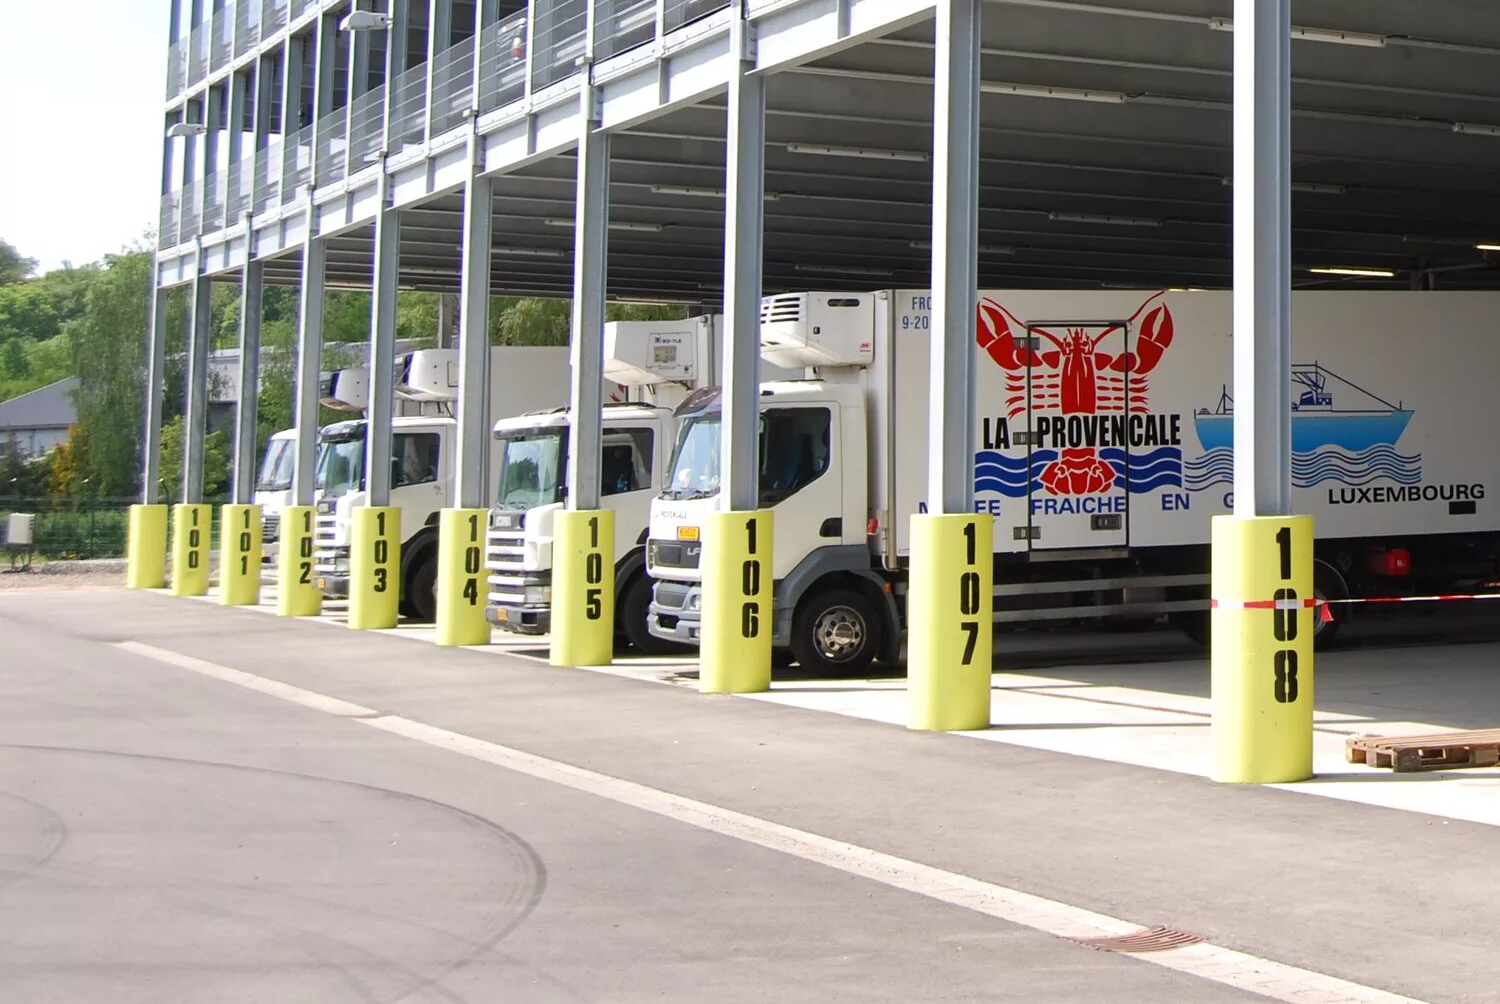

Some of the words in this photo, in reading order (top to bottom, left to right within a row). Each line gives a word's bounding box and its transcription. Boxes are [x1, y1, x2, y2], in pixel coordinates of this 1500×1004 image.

[902, 315, 929, 330] 9-20
[983, 417, 1010, 450] LA
[1036, 414, 1182, 449] PROVENCALE
[1032, 496, 1126, 515] FRAICHE
[1161, 493, 1190, 511] EN
[1328, 483, 1485, 504] LUXEMBOURG
[188, 507, 200, 569] 100
[240, 508, 251, 576] 101
[300, 510, 313, 584] 102
[373, 511, 387, 593] 103
[463, 514, 480, 606] 104
[586, 516, 602, 620] 105
[742, 518, 760, 638] 106
[960, 522, 980, 665] 107
[1274, 527, 1298, 703] 108
